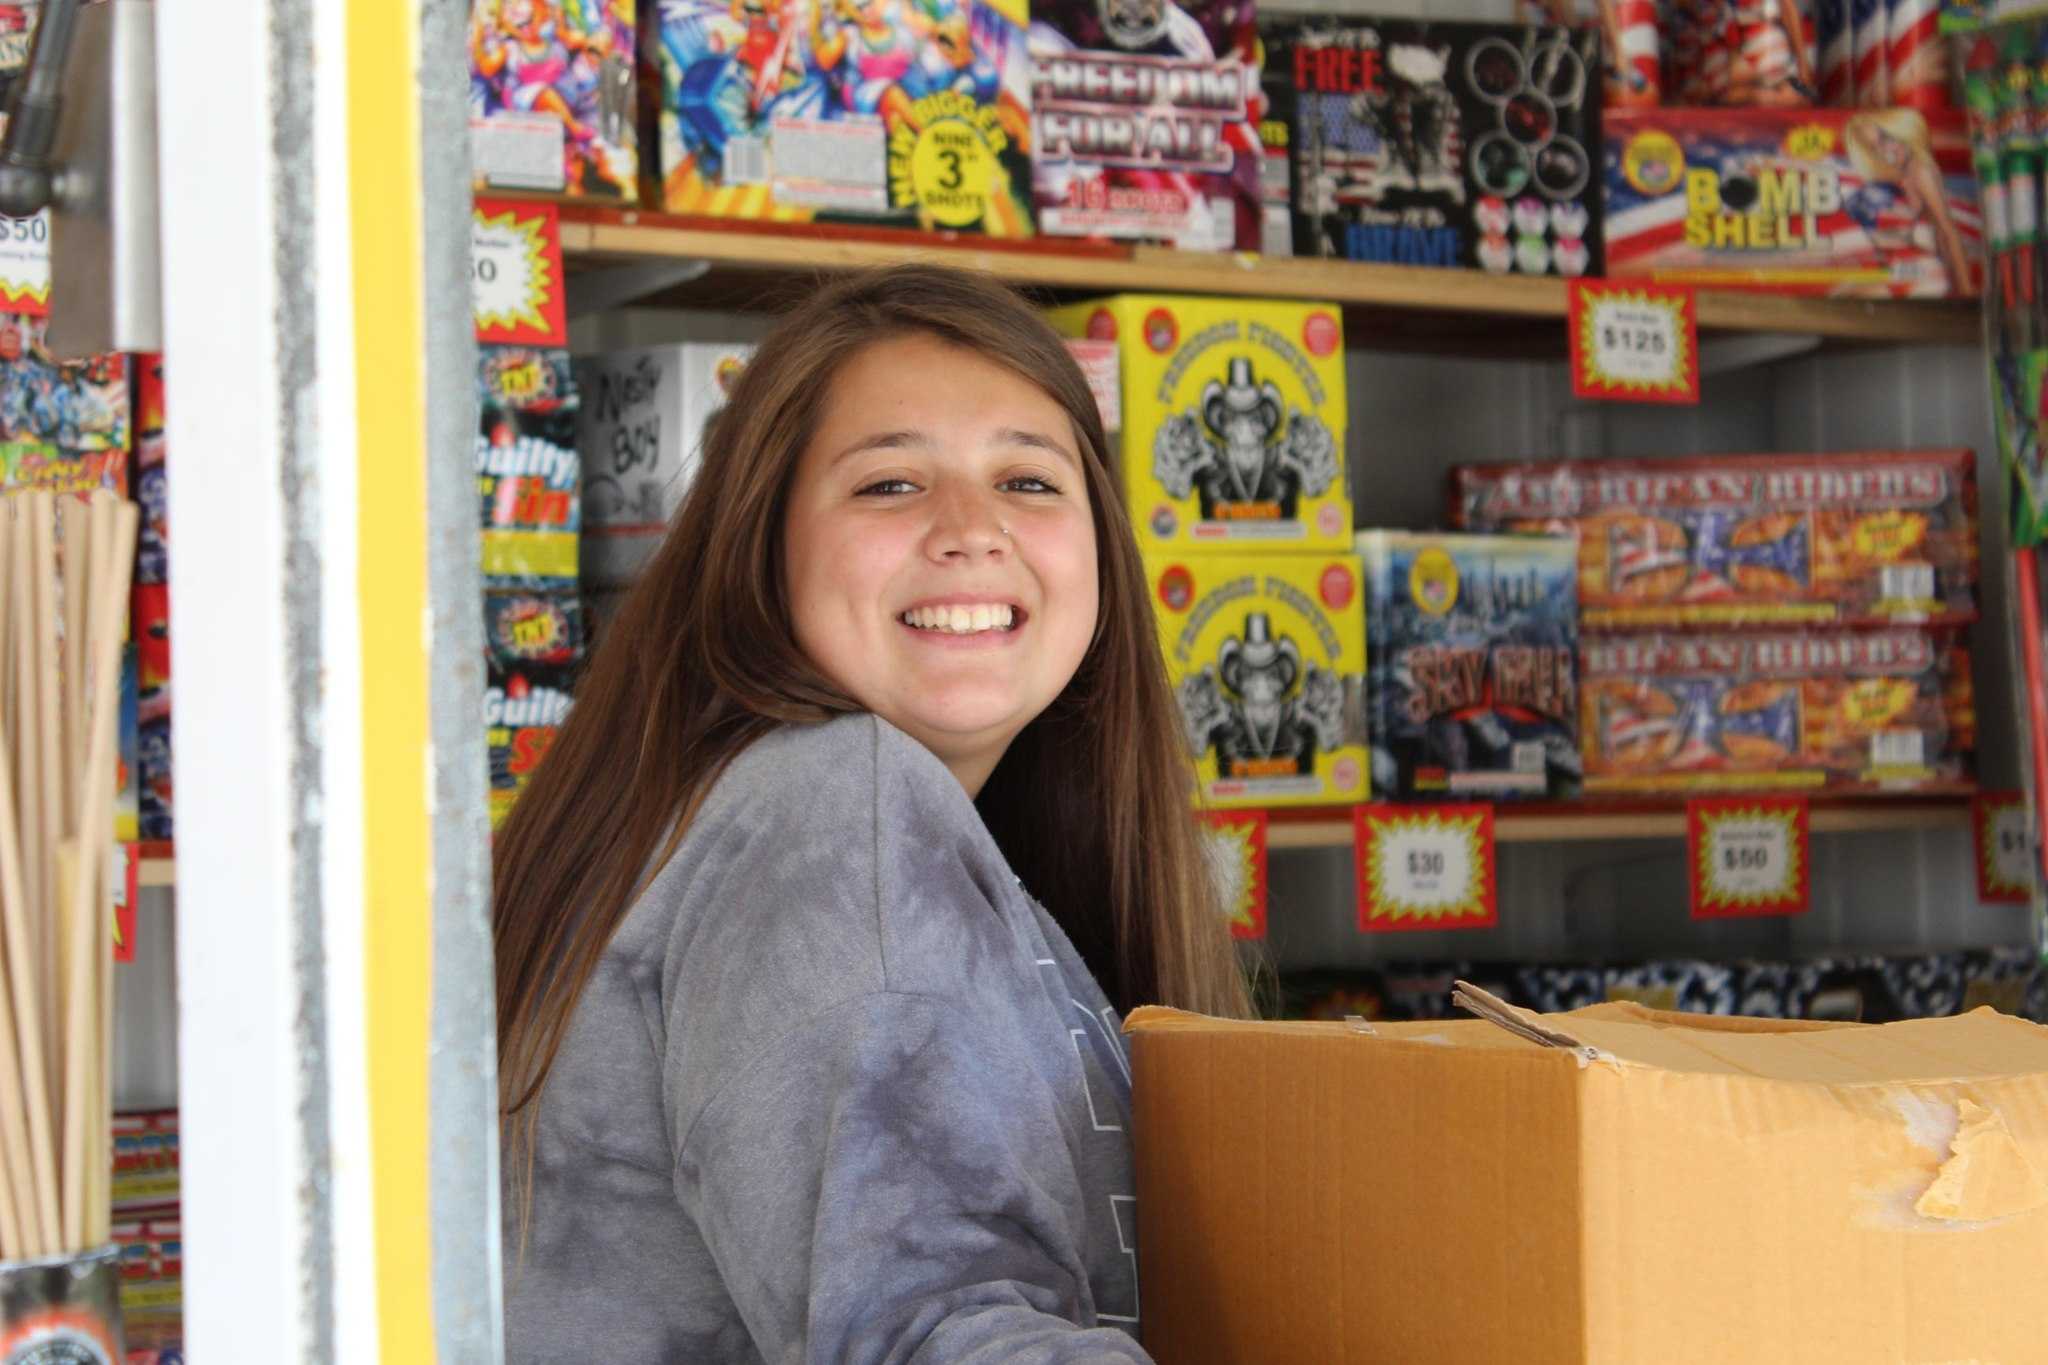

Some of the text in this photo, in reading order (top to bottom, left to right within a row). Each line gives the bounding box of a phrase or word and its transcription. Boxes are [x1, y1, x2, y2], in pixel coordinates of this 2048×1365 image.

[1034, 61, 1240, 109] FREEDOM
[1294, 44, 1385, 95] FREE
[1040, 112, 1136, 154] FOR
[1144, 112, 1228, 160] ALL
[1684, 212, 1833, 249] SHELL
[1604, 326, 1666, 354] $125
[484, 686, 574, 727] Guilt
[1407, 852, 1445, 875] $30
